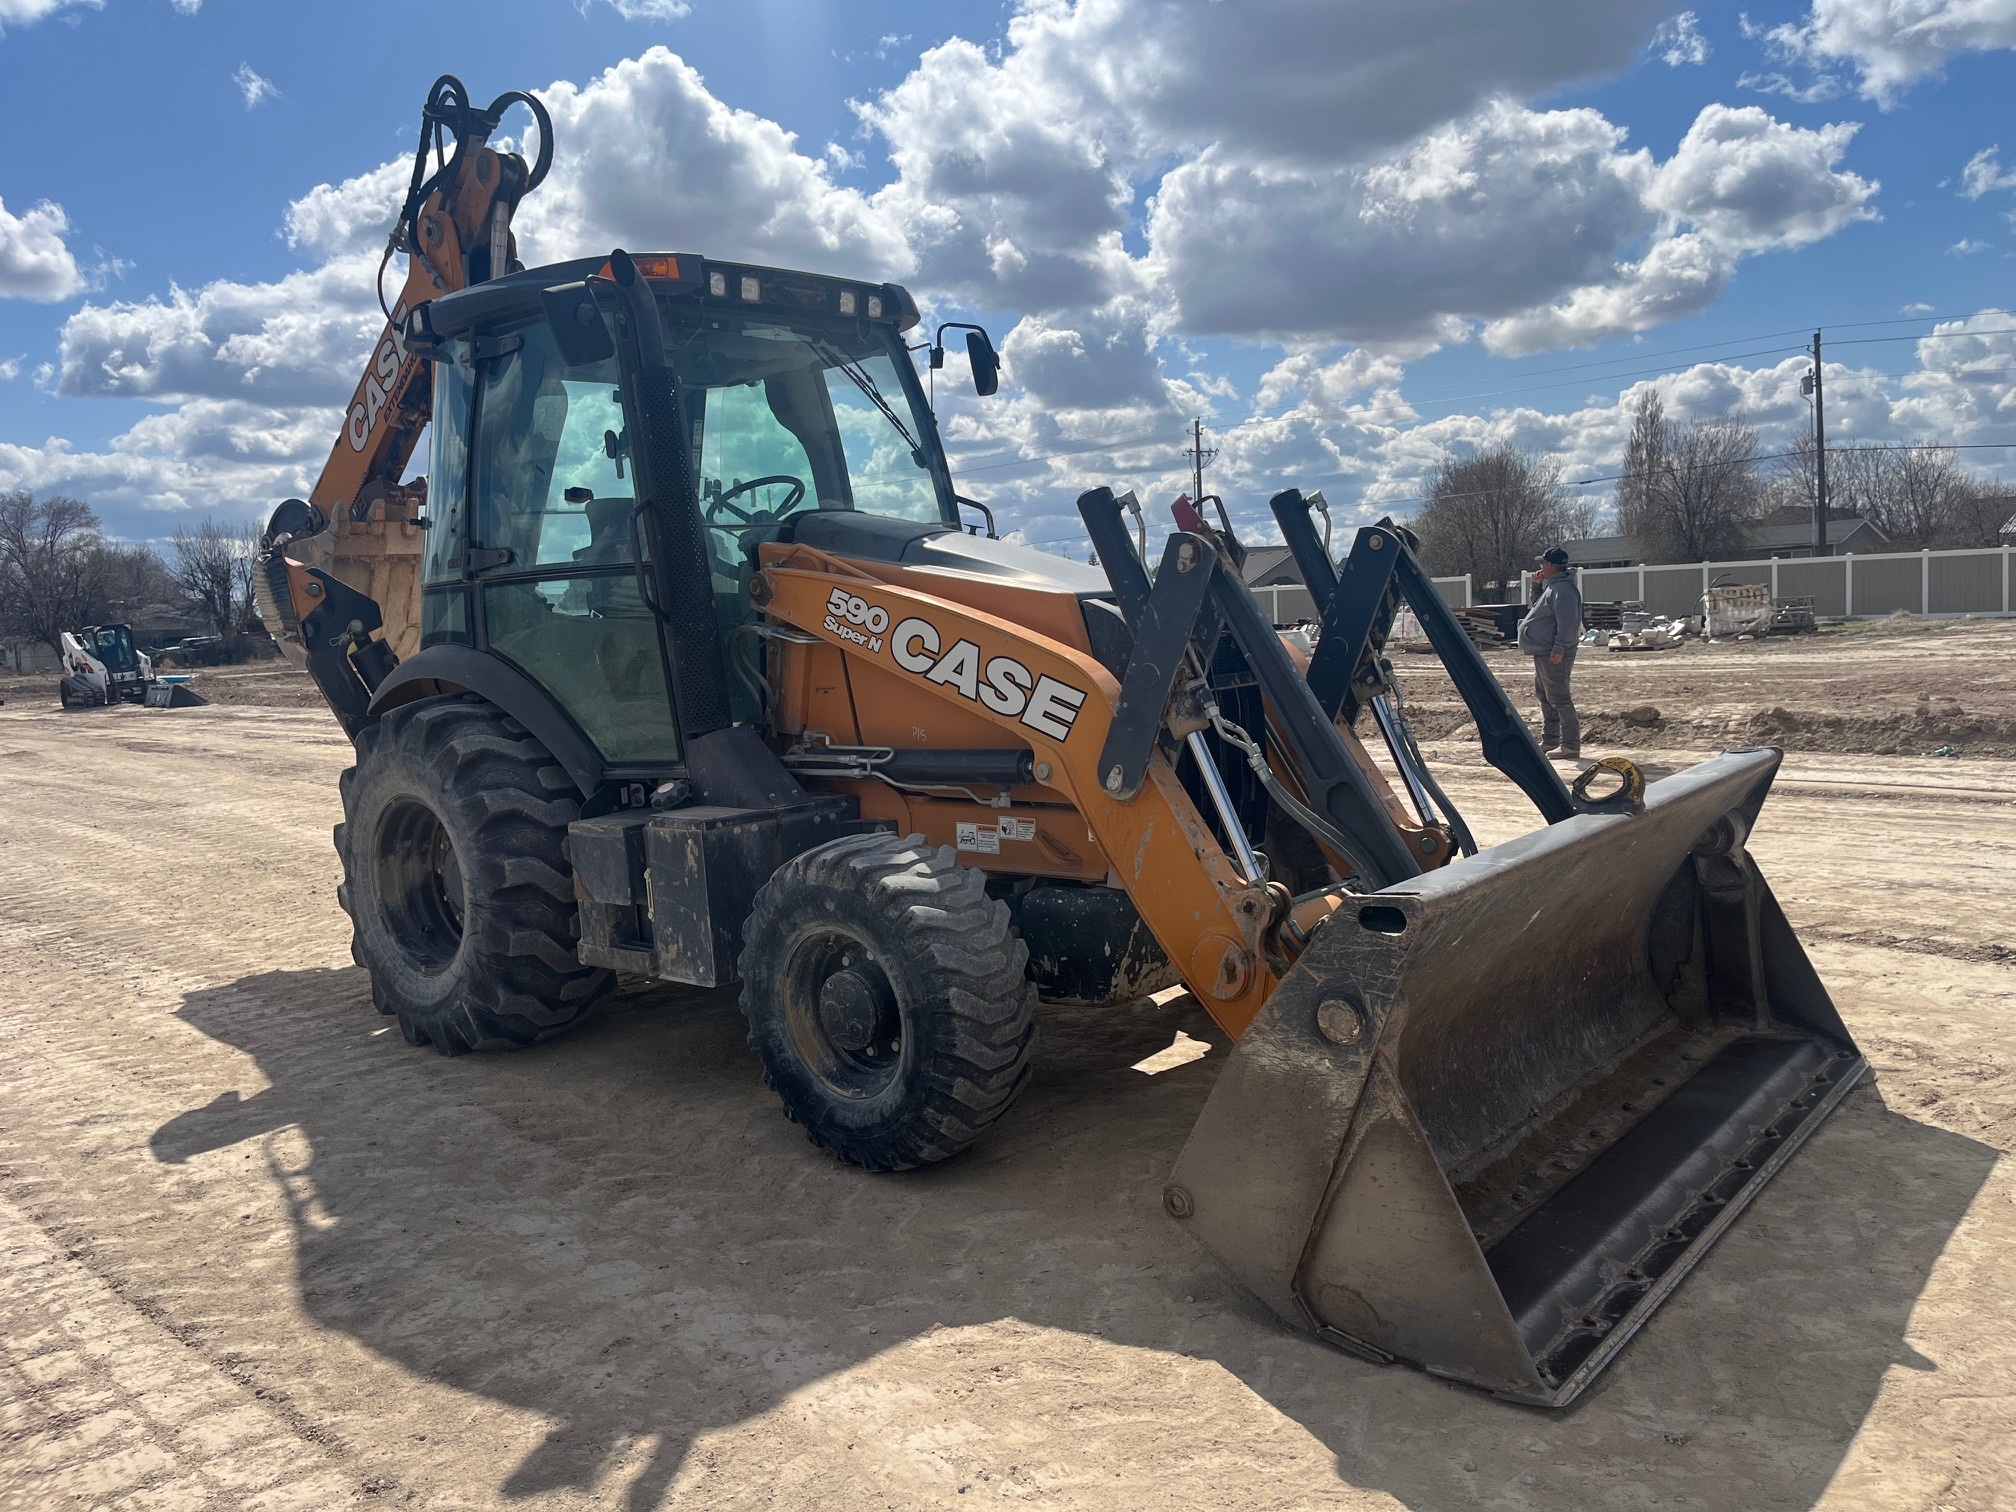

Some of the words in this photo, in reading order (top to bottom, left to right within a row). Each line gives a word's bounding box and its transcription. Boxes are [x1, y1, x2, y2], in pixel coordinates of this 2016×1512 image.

[384, 353, 417, 423] EXTENDAHO
[823, 615, 869, 647] Super
[867, 635, 884, 654] N
[826, 586, 890, 635] 590
[890, 616, 1088, 743] CASE
